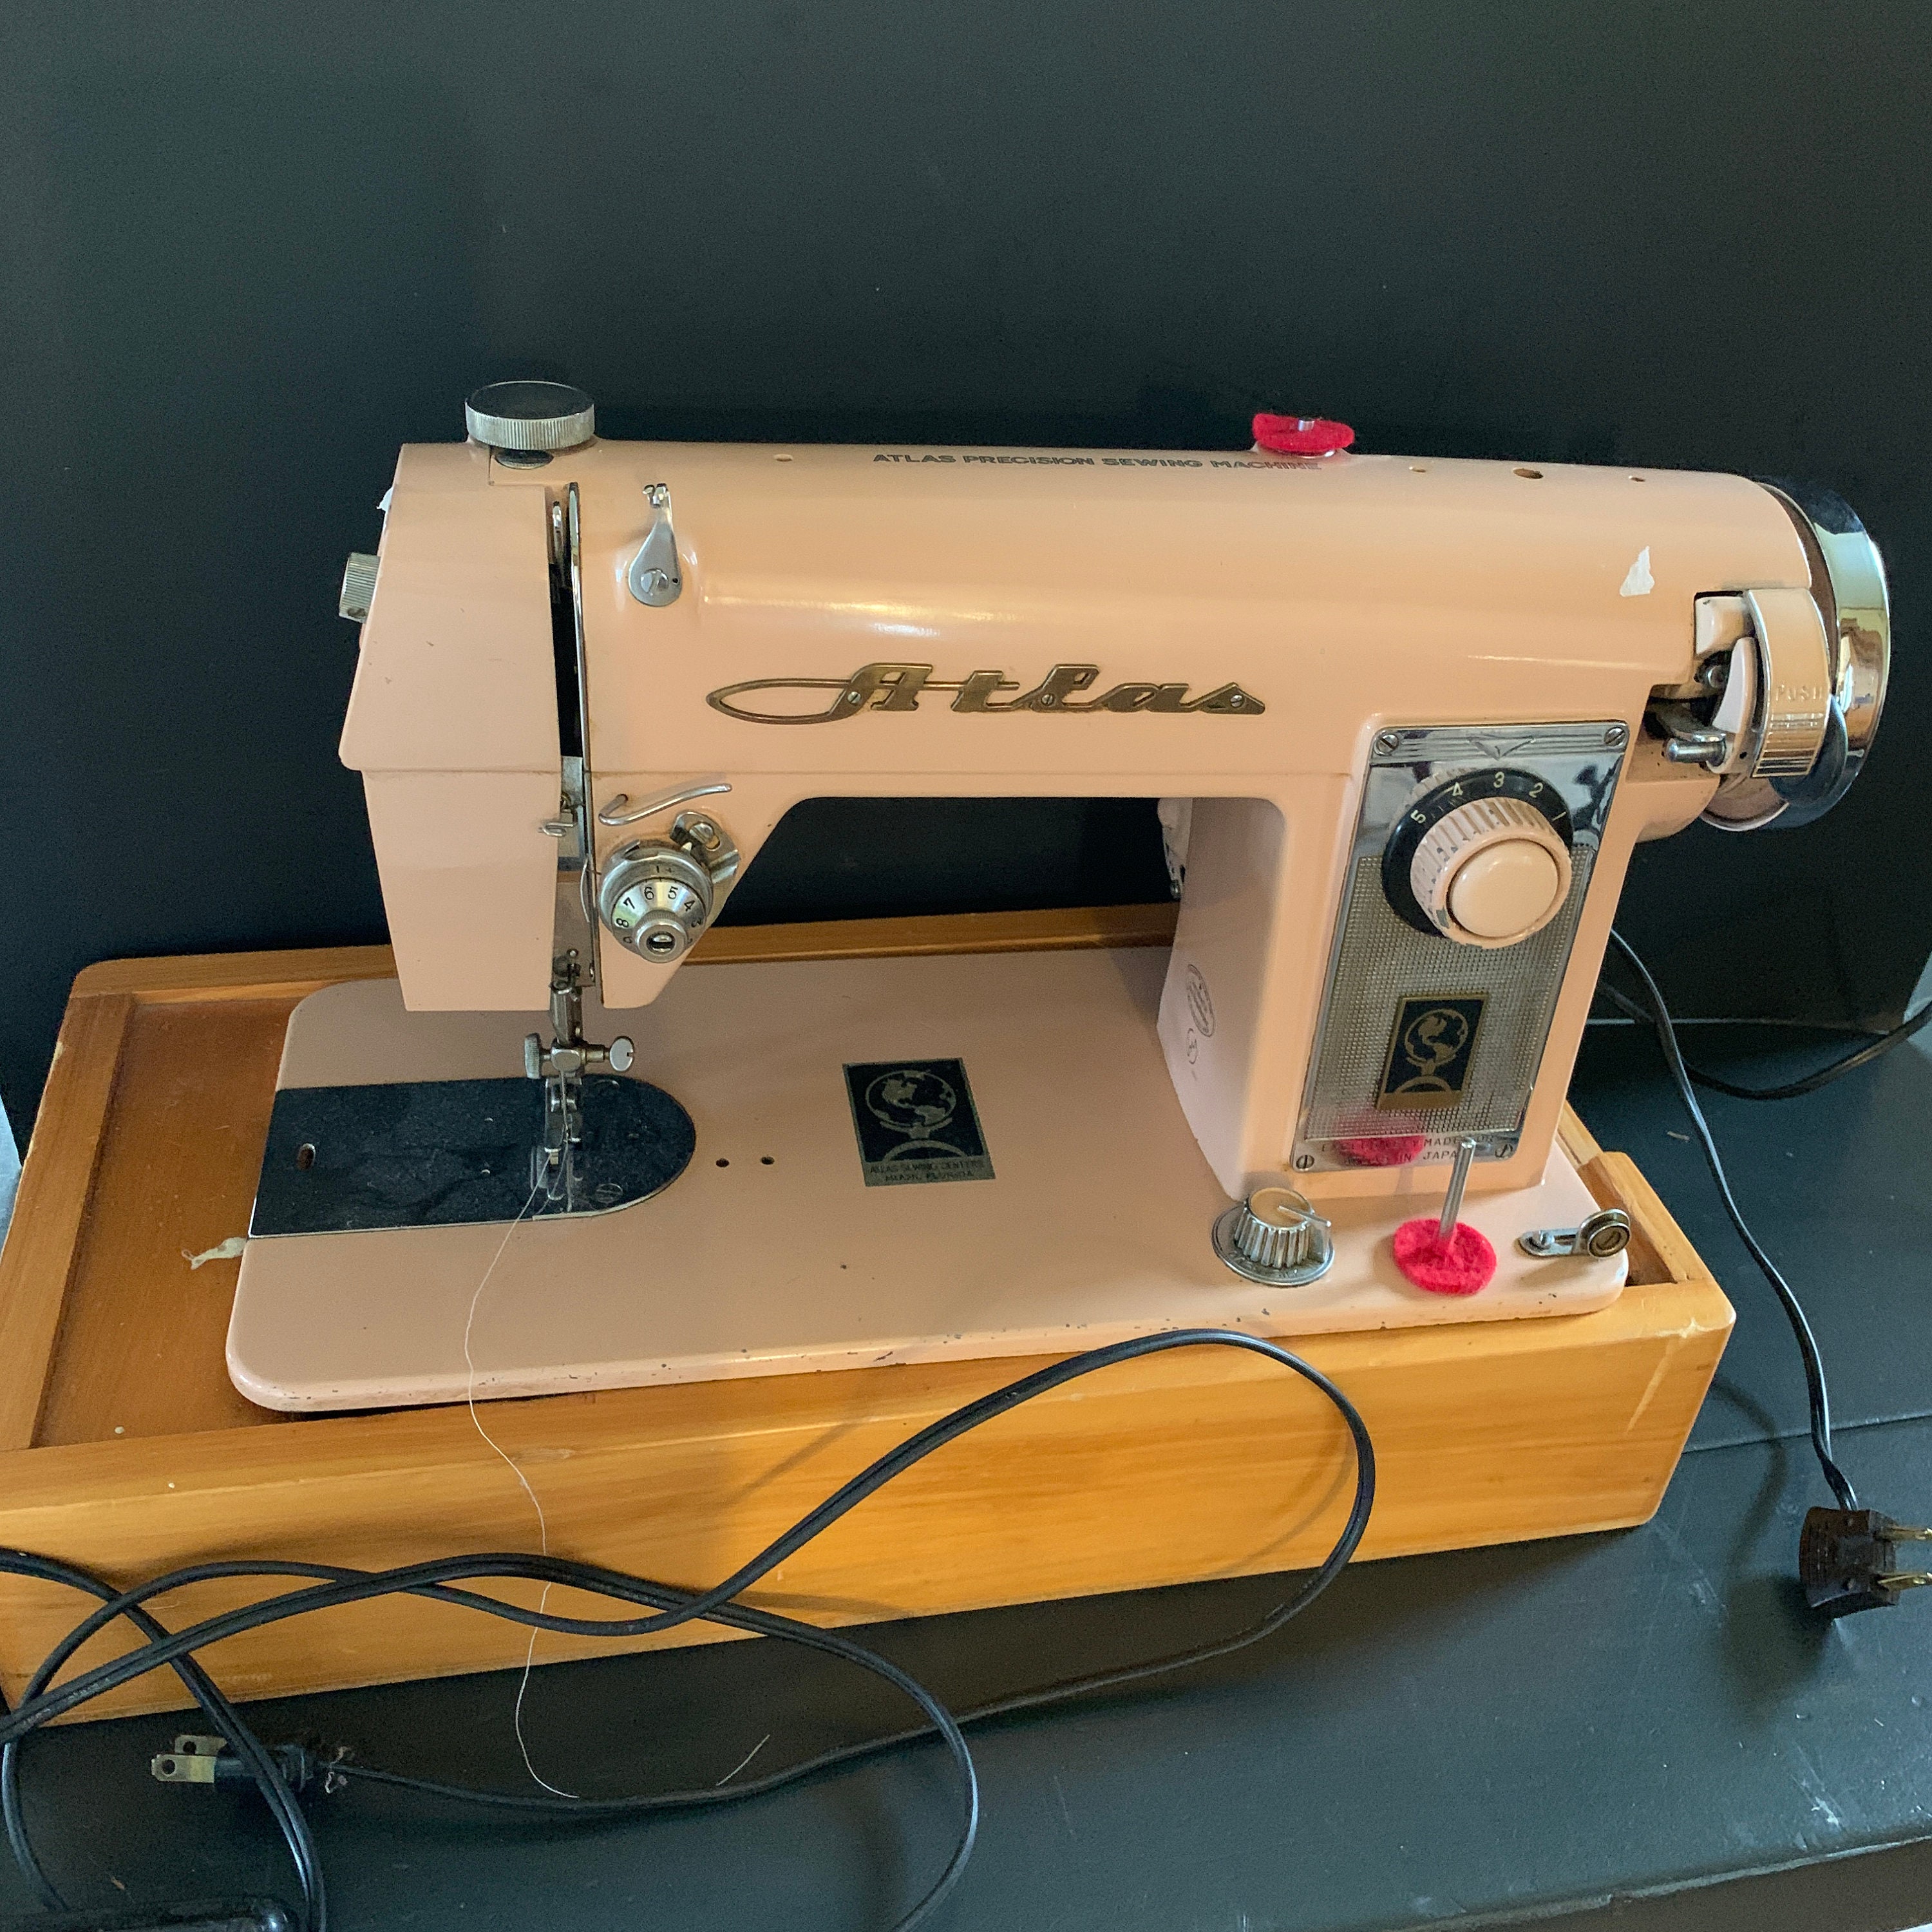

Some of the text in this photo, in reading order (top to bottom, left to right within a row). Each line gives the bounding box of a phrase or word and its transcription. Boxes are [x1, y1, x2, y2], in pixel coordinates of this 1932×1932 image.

[873, 454, 1321, 470] ATLAS PRECISION SEWING MACHINE
[706, 663, 1265, 725] Atlas
[1410, 772, 1566, 824] 5 4 3 2 1
[616, 918, 629, 928] 8
[623, 896, 635, 909] 7
[643, 886, 655, 900] 6
[668, 886, 679, 900] 5
[684, 900, 696, 912] 4
[691, 919, 702, 928] 3
[1399, 1153, 1412, 1162] IN
[1423, 1150, 1457, 1160] JAPA
[1423, 1137, 1459, 1146] MADE
